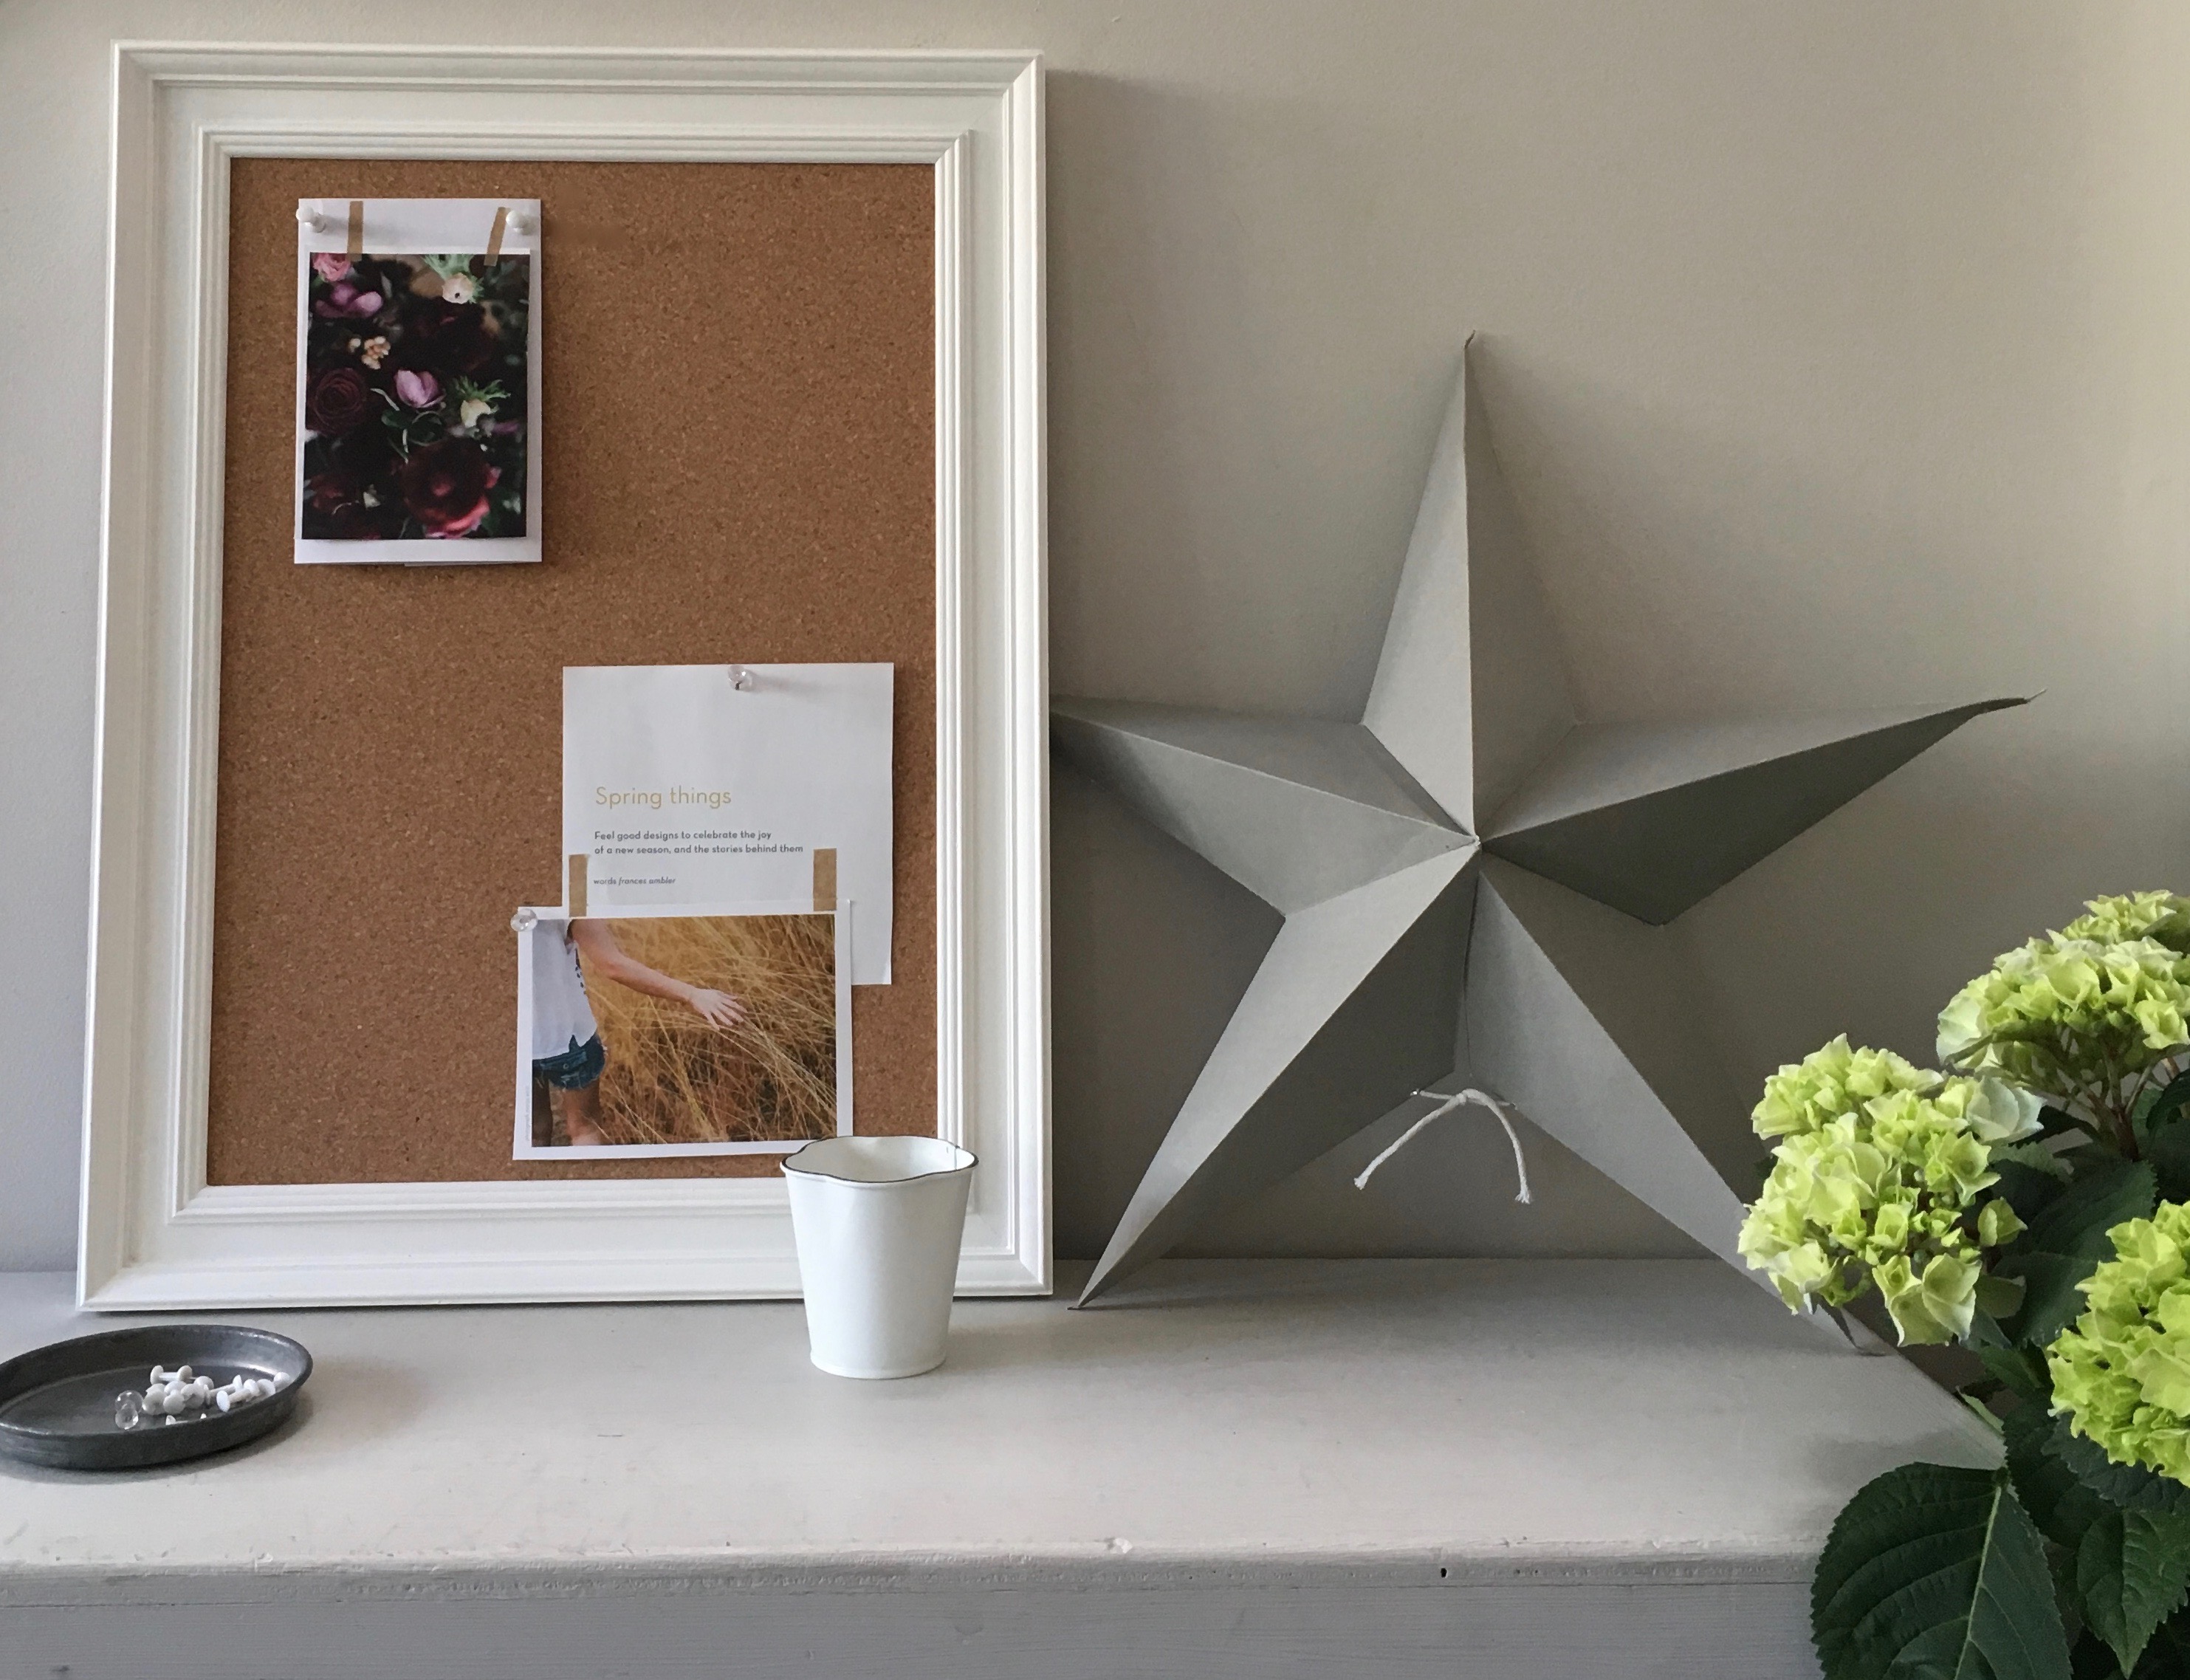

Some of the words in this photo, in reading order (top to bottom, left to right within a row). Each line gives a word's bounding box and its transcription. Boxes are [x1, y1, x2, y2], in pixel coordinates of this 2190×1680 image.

[596, 786, 662, 809] Spring
[670, 785, 732, 809] things
[594, 831, 615, 840] Feel
[617, 831, 641, 842] good
[643, 831, 679, 841] designs
[693, 830, 738, 839] celebrate
[758, 830, 772, 840] joy
[594, 846, 604, 854] of
[674, 845, 692, 854] and
[694, 845, 710, 853] the
[712, 844, 743, 853] stories
[745, 844, 778, 853] behind
[780, 844, 803, 852] them
[618, 877, 647, 886] frances
